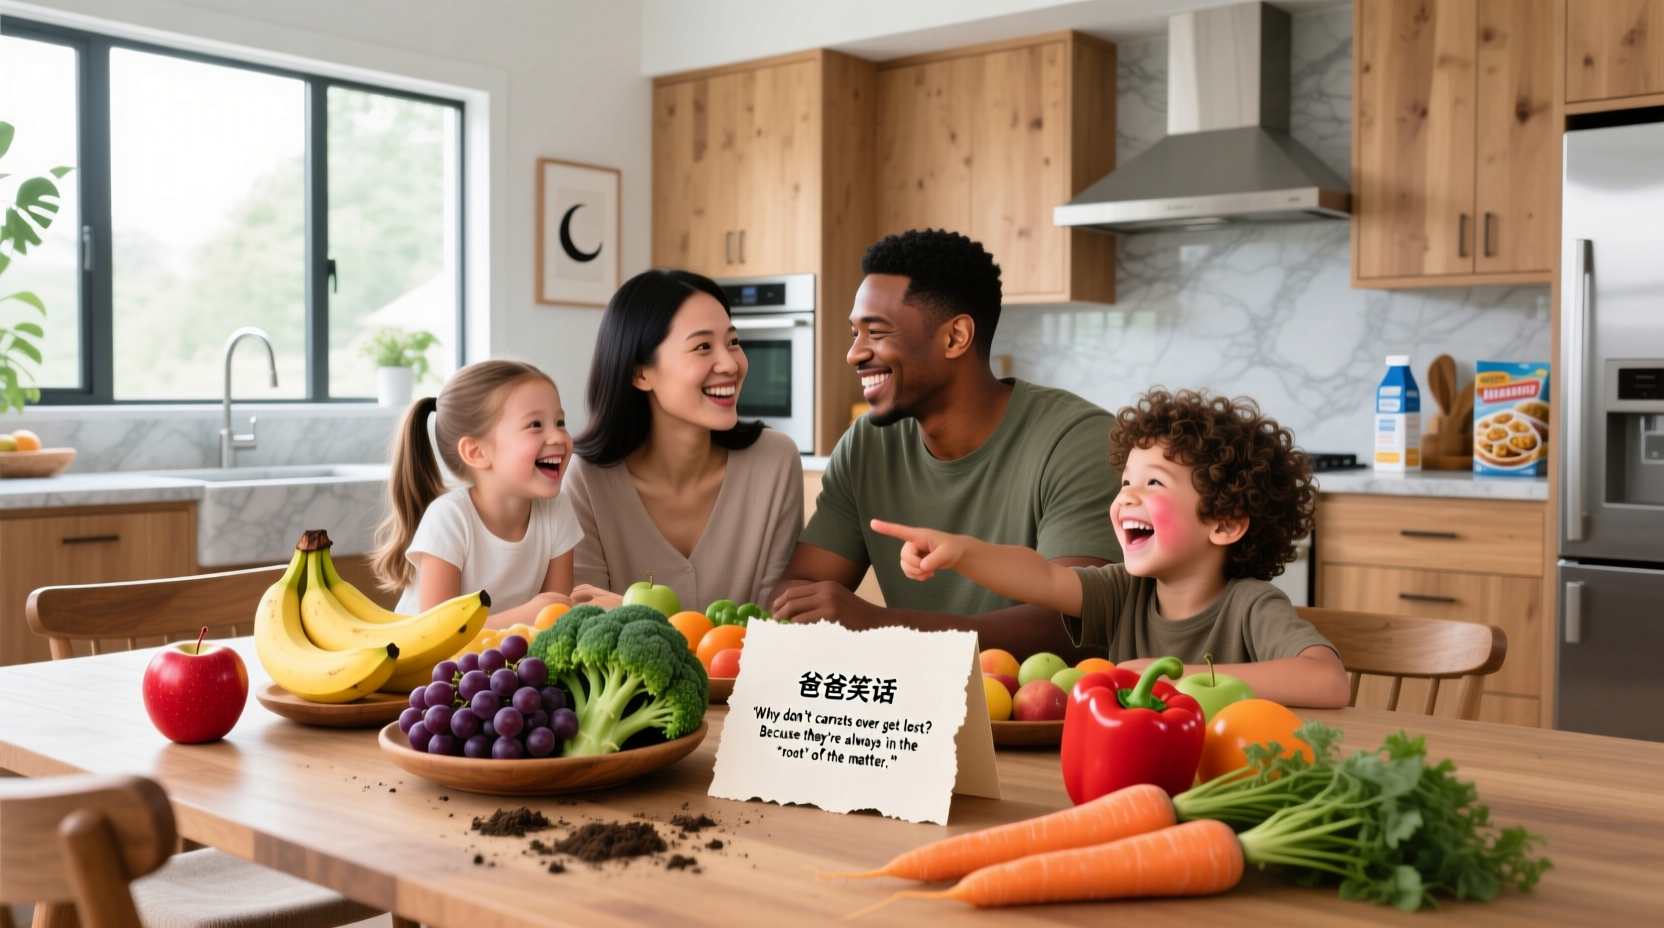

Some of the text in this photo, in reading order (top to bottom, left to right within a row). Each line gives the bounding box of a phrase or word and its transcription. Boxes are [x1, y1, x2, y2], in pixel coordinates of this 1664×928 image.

[798, 671, 898, 704] 爸爸笑话
[881, 718, 900, 734] get
[844, 732, 882, 751] always
[886, 736, 896, 750] in
[899, 737, 919, 752] the
[827, 749, 845, 763] the
